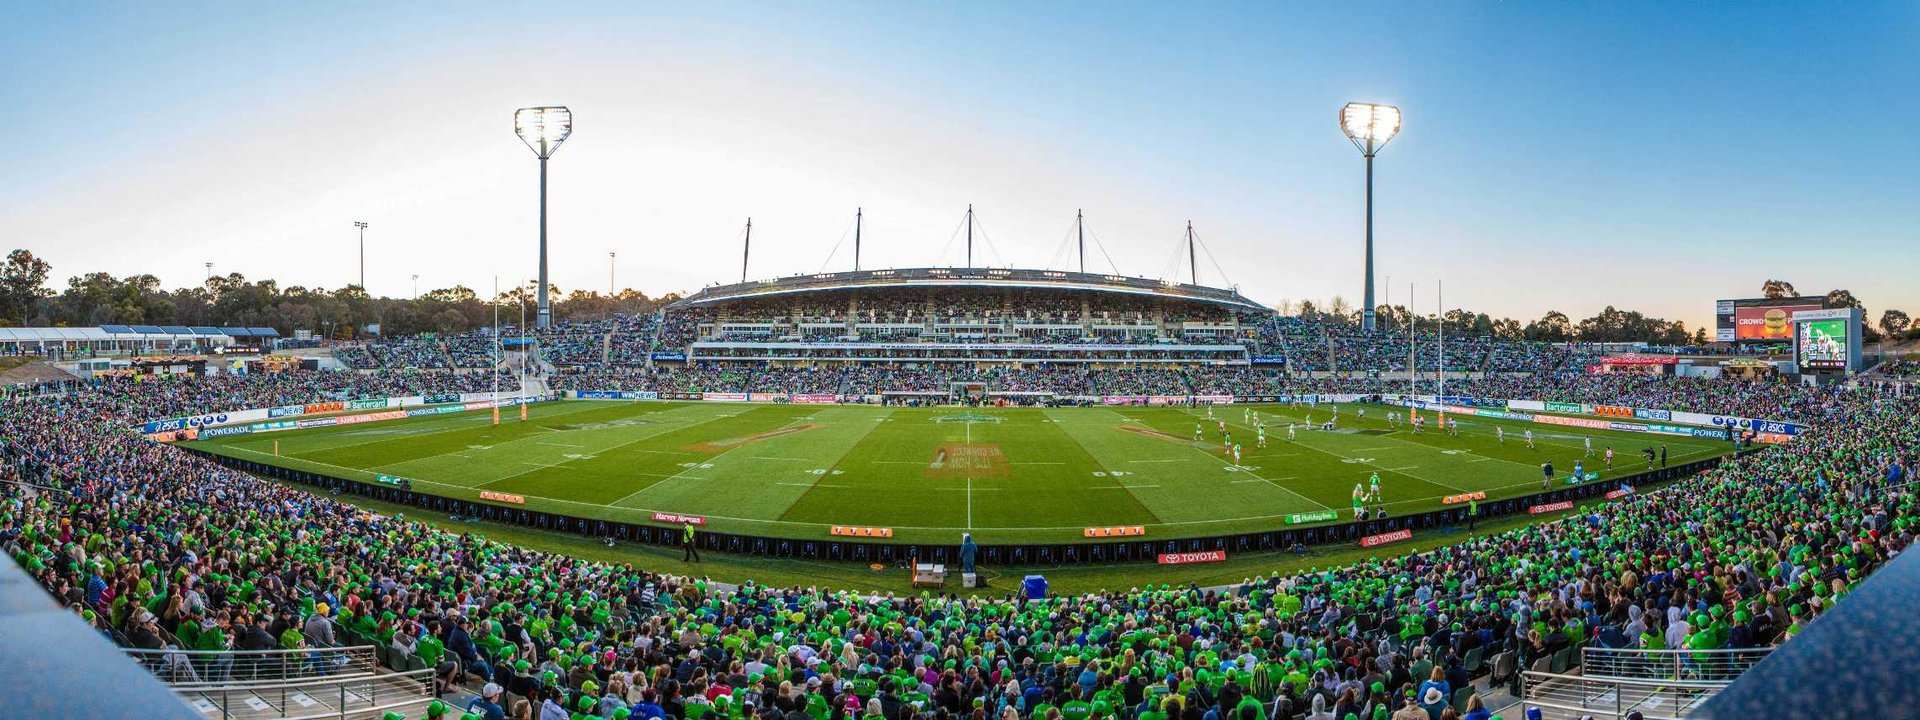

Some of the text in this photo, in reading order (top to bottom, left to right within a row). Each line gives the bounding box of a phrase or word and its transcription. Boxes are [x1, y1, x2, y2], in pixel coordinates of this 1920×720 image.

[635, 391, 657, 399] NEWS
[352, 399, 386, 410] Bartercard
[1546, 403, 1580, 413] Bartercard
[271, 406, 303, 416] WIN NEWS
[1636, 409, 1668, 419] WIN NEWS
[204, 426, 251, 437] POWERADE
[1546, 502, 1569, 511] TOYOTA
[655, 513, 701, 523] Harvey Norman
[1379, 531, 1407, 542] TOYOTA
[1182, 552, 1219, 562] TOYOTA
